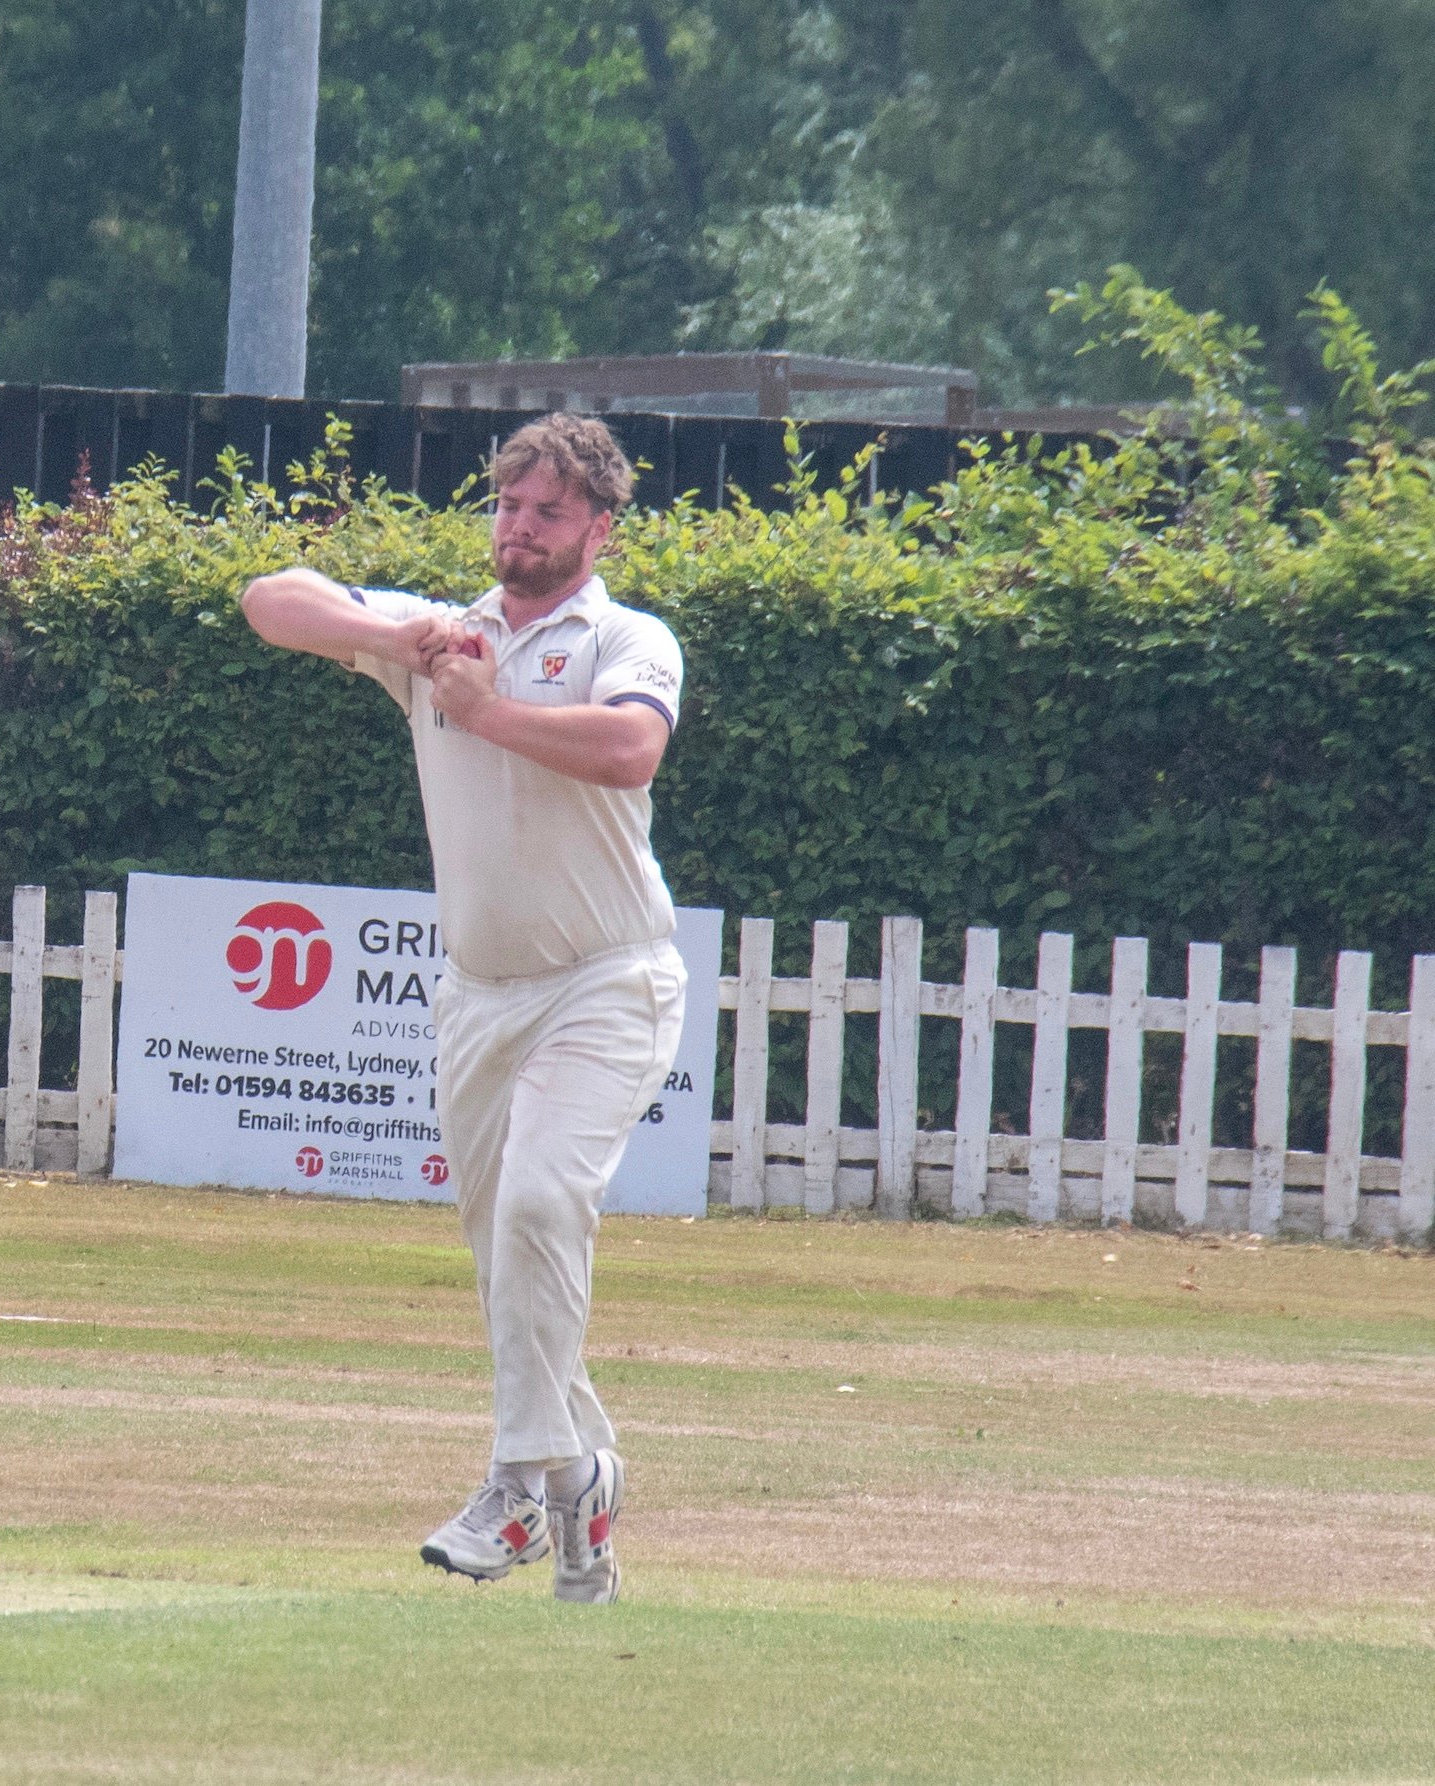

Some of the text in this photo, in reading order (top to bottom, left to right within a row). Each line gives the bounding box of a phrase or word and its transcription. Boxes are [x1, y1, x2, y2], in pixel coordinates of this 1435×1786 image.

[358, 918, 447, 958] GRI
[355, 969, 443, 1008] MA
[144, 1038, 172, 1058] 20
[177, 1039, 269, 1066] Newerne
[274, 1046, 341, 1073] Street,
[348, 1051, 424, 1080] Lydney,
[169, 1071, 664, 1124] Tel: 01594 843635 6
[238, 1109, 441, 1142] Email: info@griffiths
[329, 1166, 404, 1180] MARSHALL
[330, 1151, 403, 1167] GRIFFITHS
